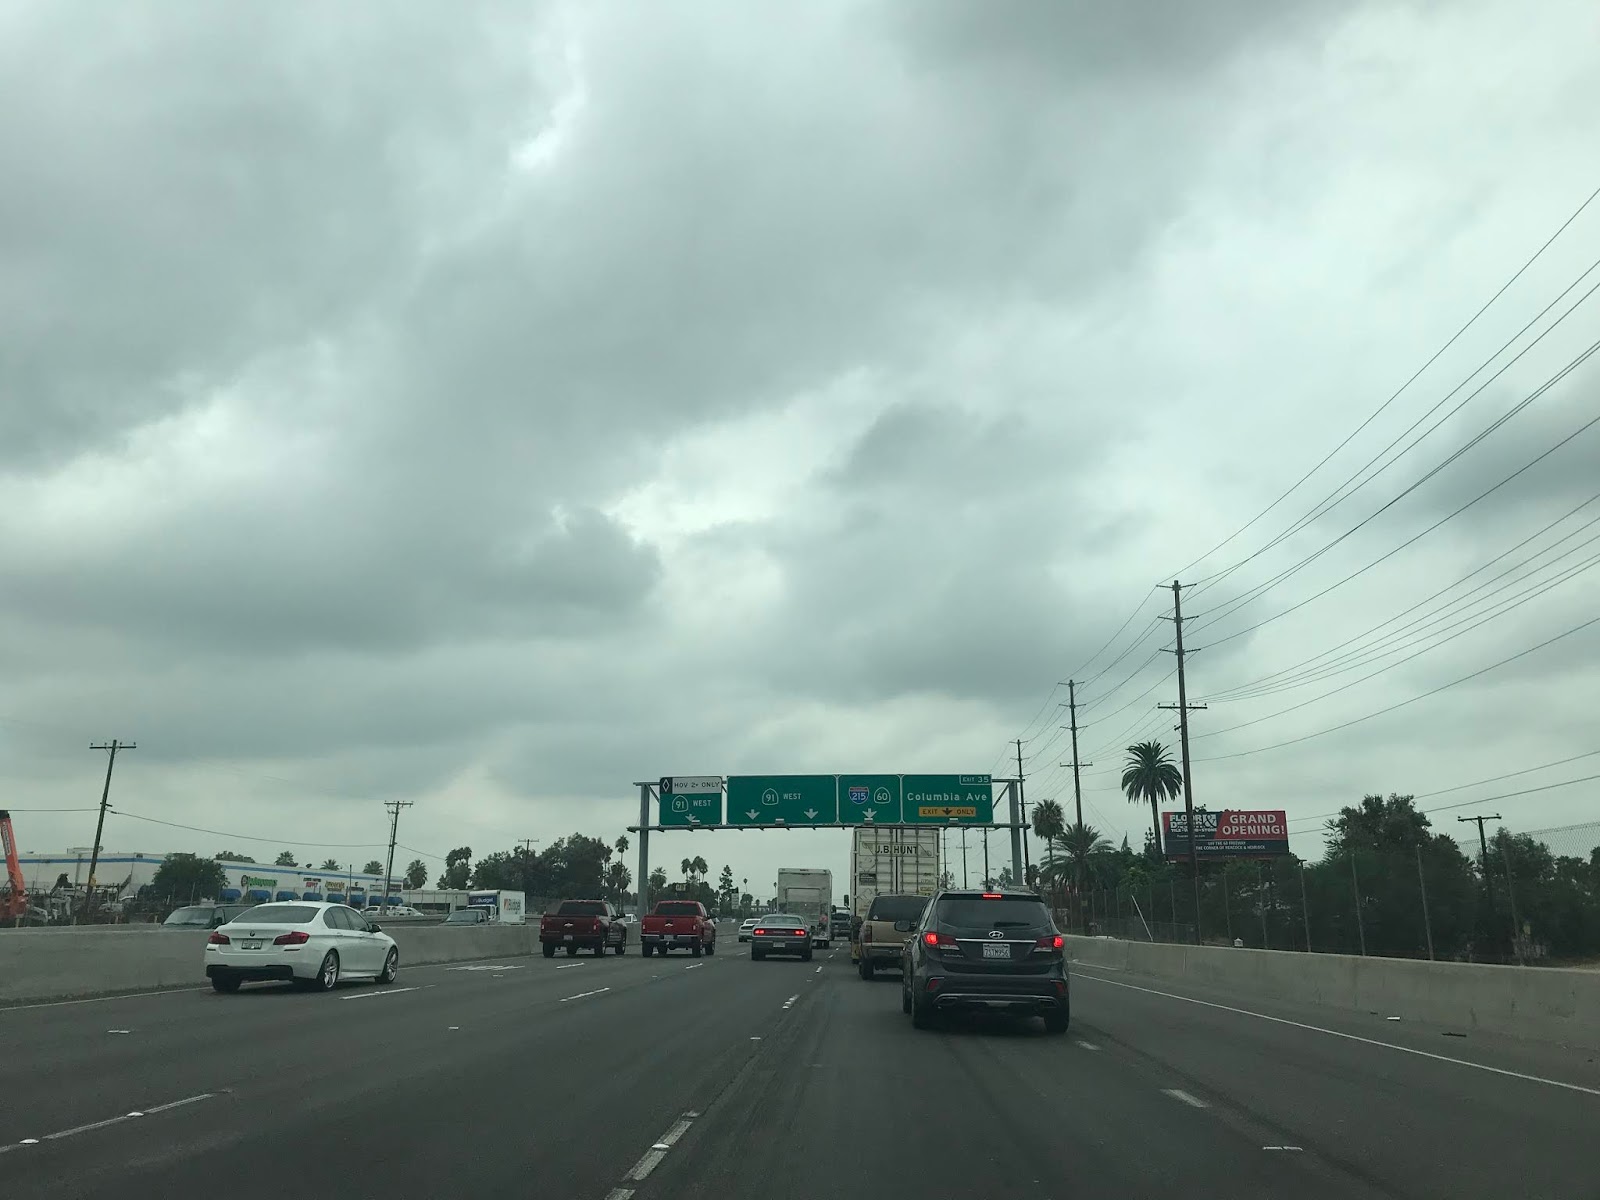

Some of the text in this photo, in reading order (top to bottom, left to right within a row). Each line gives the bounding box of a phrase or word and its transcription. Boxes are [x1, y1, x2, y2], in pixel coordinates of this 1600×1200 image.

[852, 792, 866, 800] 215
[876, 793, 888, 801] 60
[907, 793, 960, 801] Columbia
[1230, 815, 1276, 824] GRAND
[1222, 825, 1285, 834] OPENING!
[893, 846, 918, 854] HUNT
